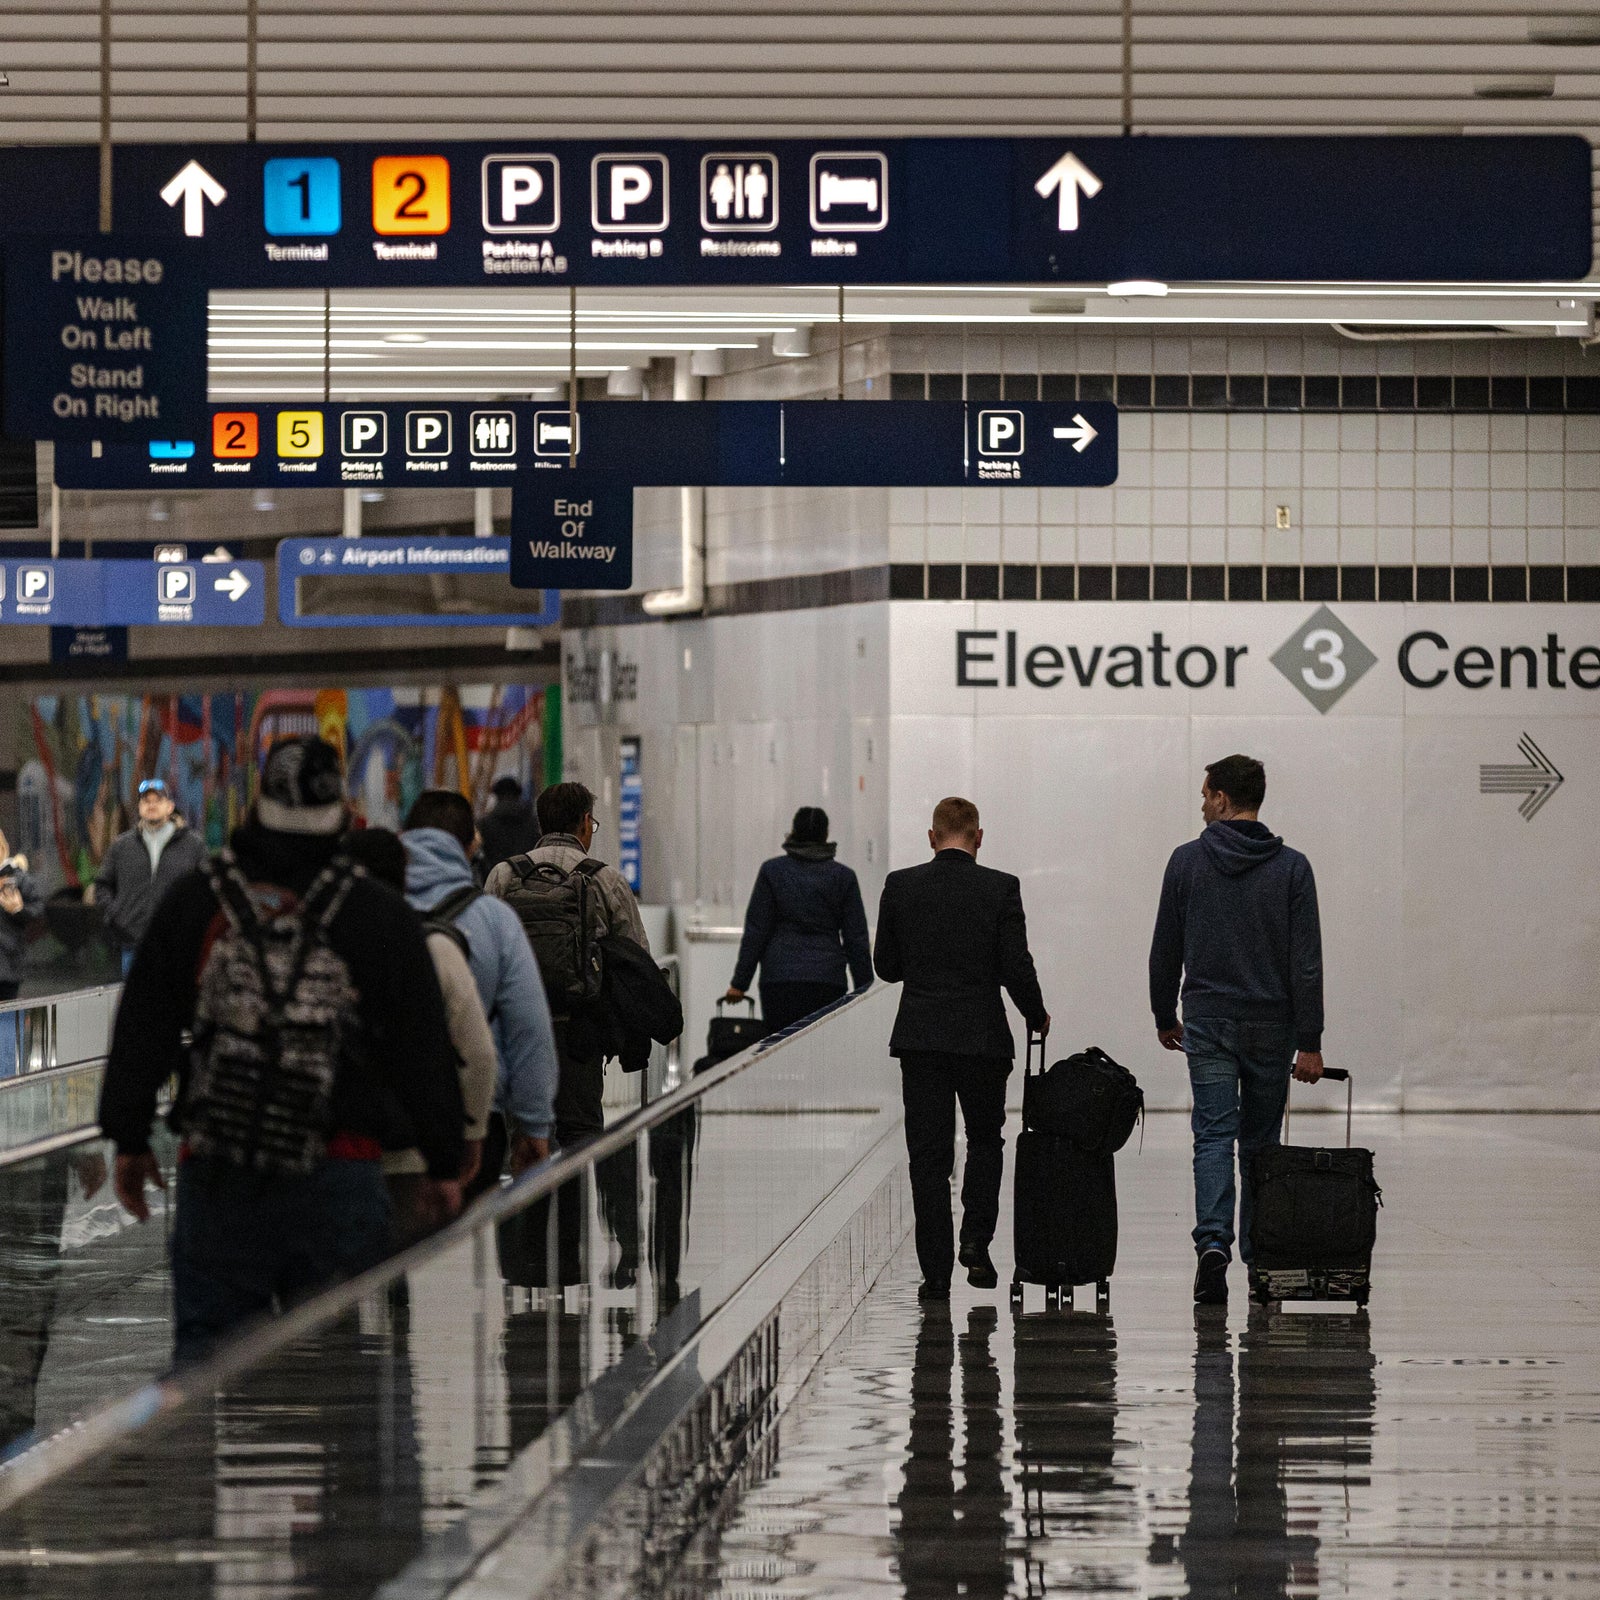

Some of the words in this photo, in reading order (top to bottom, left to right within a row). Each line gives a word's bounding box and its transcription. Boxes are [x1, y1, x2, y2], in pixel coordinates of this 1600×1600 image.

[288, 171, 310, 219] 1
[395, 171, 428, 218] 2
[501, 165, 543, 222] P
[611, 165, 652, 221] P
[265, 244, 328, 260] Terminal
[373, 243, 437, 260] Terminal
[483, 241, 539, 258] Parking
[541, 240, 555, 257] A
[592, 240, 648, 259] Parking
[701, 239, 781, 256] Restrooms
[52, 251, 162, 284] Please
[484, 259, 540, 274] Section
[77, 297, 136, 321] Walk
[61, 325, 96, 349] On
[105, 327, 151, 350] Left
[71, 364, 143, 388] Stand
[53, 394, 88, 417] On
[95, 394, 158, 422] Right
[226, 420, 246, 449] 2
[291, 420, 309, 448] 5
[353, 418, 377, 449] P
[418, 418, 441, 449] P
[990, 417, 1014, 448] P
[149, 463, 187, 472] Terminal
[213, 463, 250, 472] Terminal
[278, 462, 317, 471] Terminal
[341, 462, 373, 470] Parking
[375, 462, 383, 470] A
[342, 471, 374, 480] Section
[406, 462, 439, 471] Parking
[440, 461, 448, 470] B
[470, 462, 517, 470] Restrooms
[978, 461, 1011, 471] Parking
[1012, 461, 1020, 469] A
[979, 470, 1012, 478] Section
[554, 499, 592, 516] End
[562, 521, 584, 537] Of
[342, 548, 404, 567] Airport
[407, 547, 508, 563] Information
[529, 541, 616, 562] Walkway
[26, 572, 45, 596] P
[167, 572, 187, 598] P
[957, 631, 1248, 688] Elevator
[1300, 629, 1346, 691] 3
[1398, 631, 1600, 690] Cente
